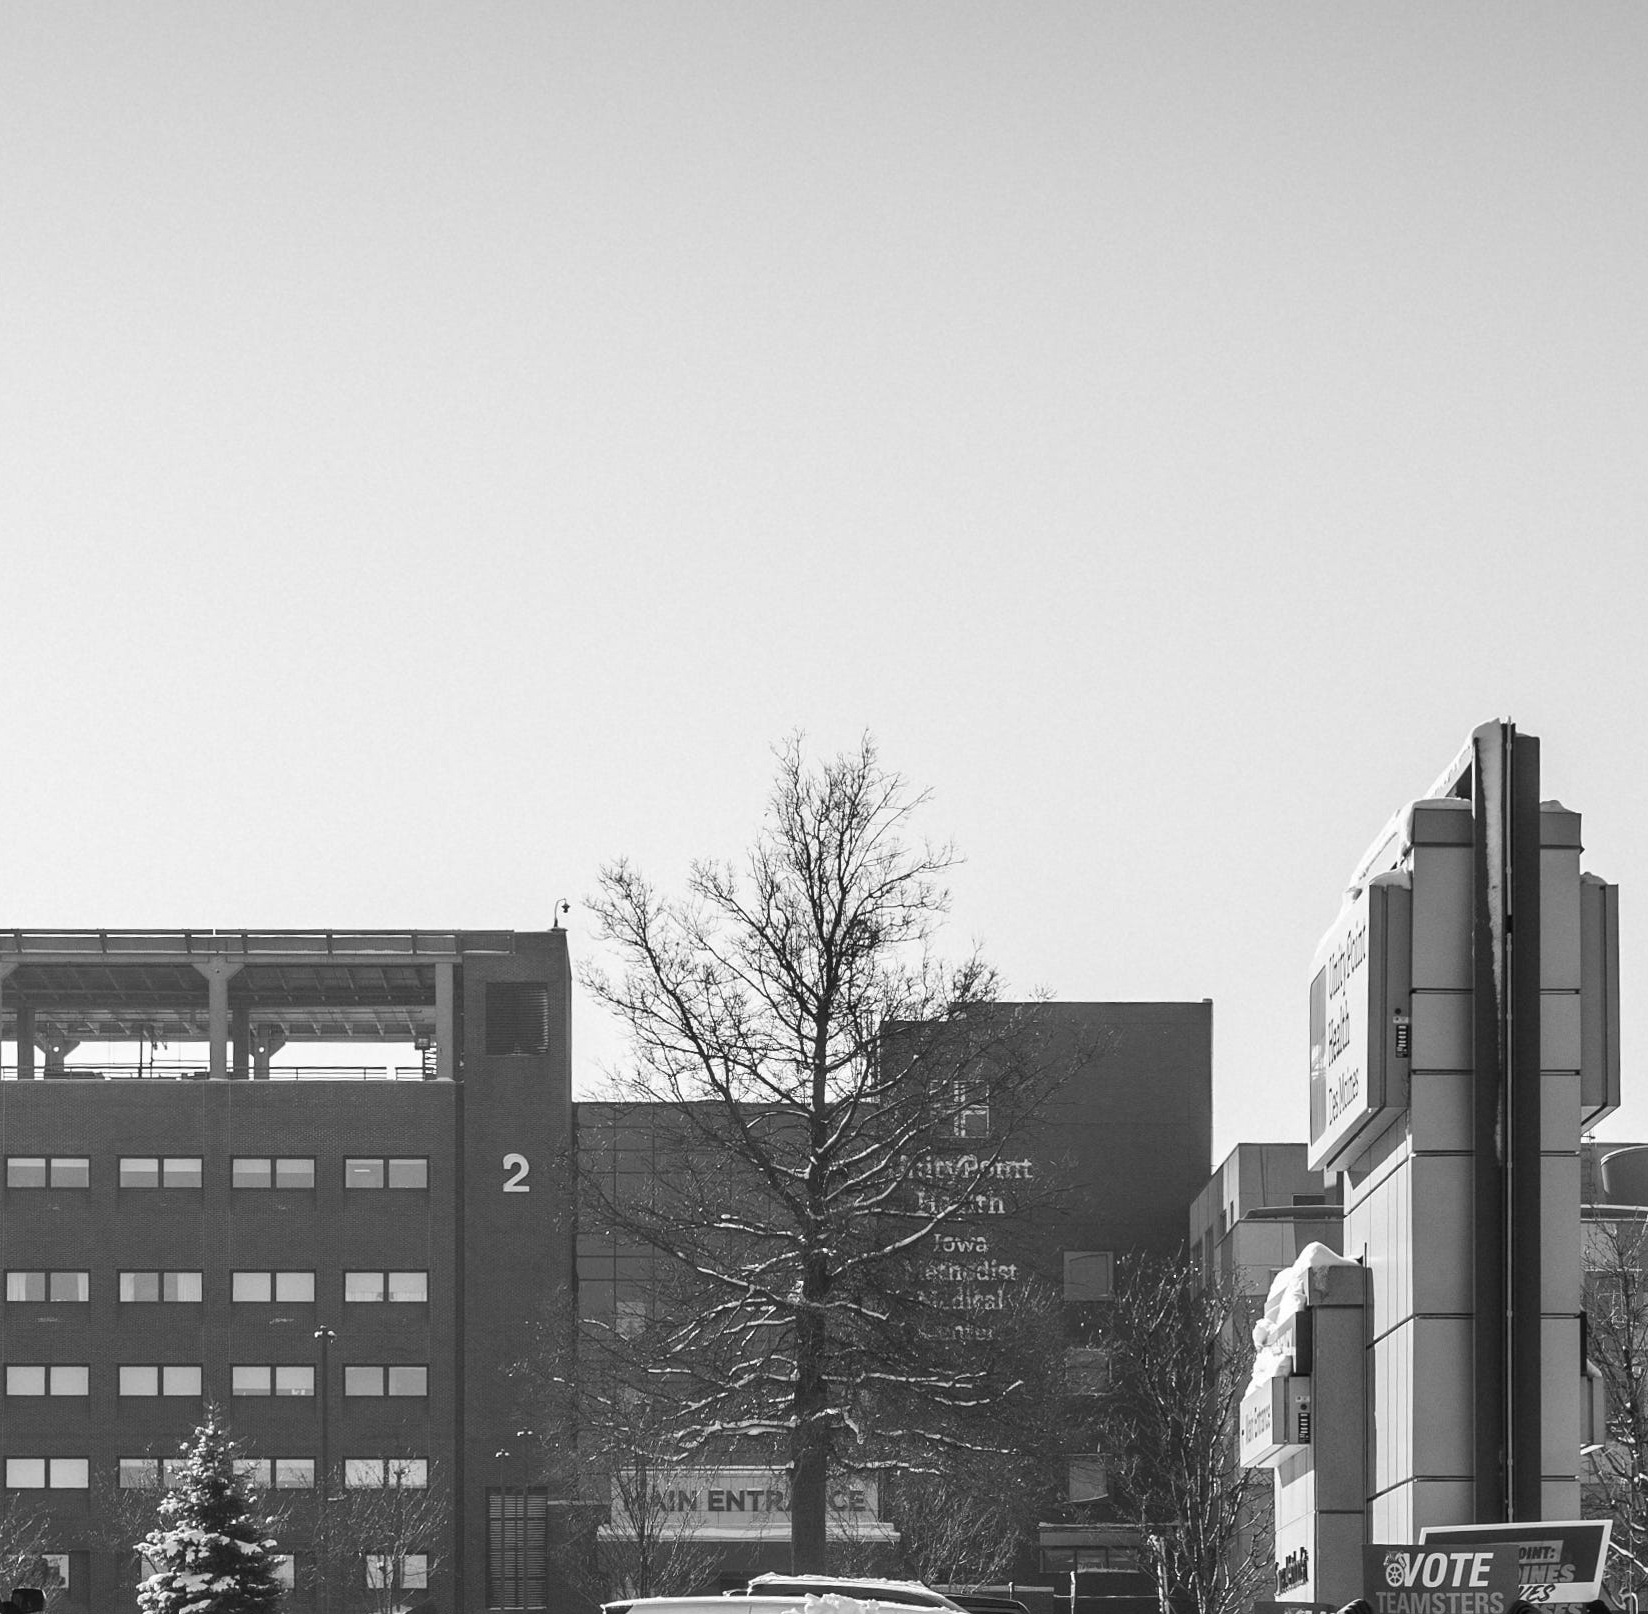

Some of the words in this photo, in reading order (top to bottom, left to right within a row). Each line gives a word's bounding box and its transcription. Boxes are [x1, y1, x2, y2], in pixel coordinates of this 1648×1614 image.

[1328, 1000, 1350, 1067] Health
[503, 1153, 530, 1192] 2
[1404, 1552, 1494, 1588] VOTE
[1375, 1591, 1505, 1614] TEAMSTERS
